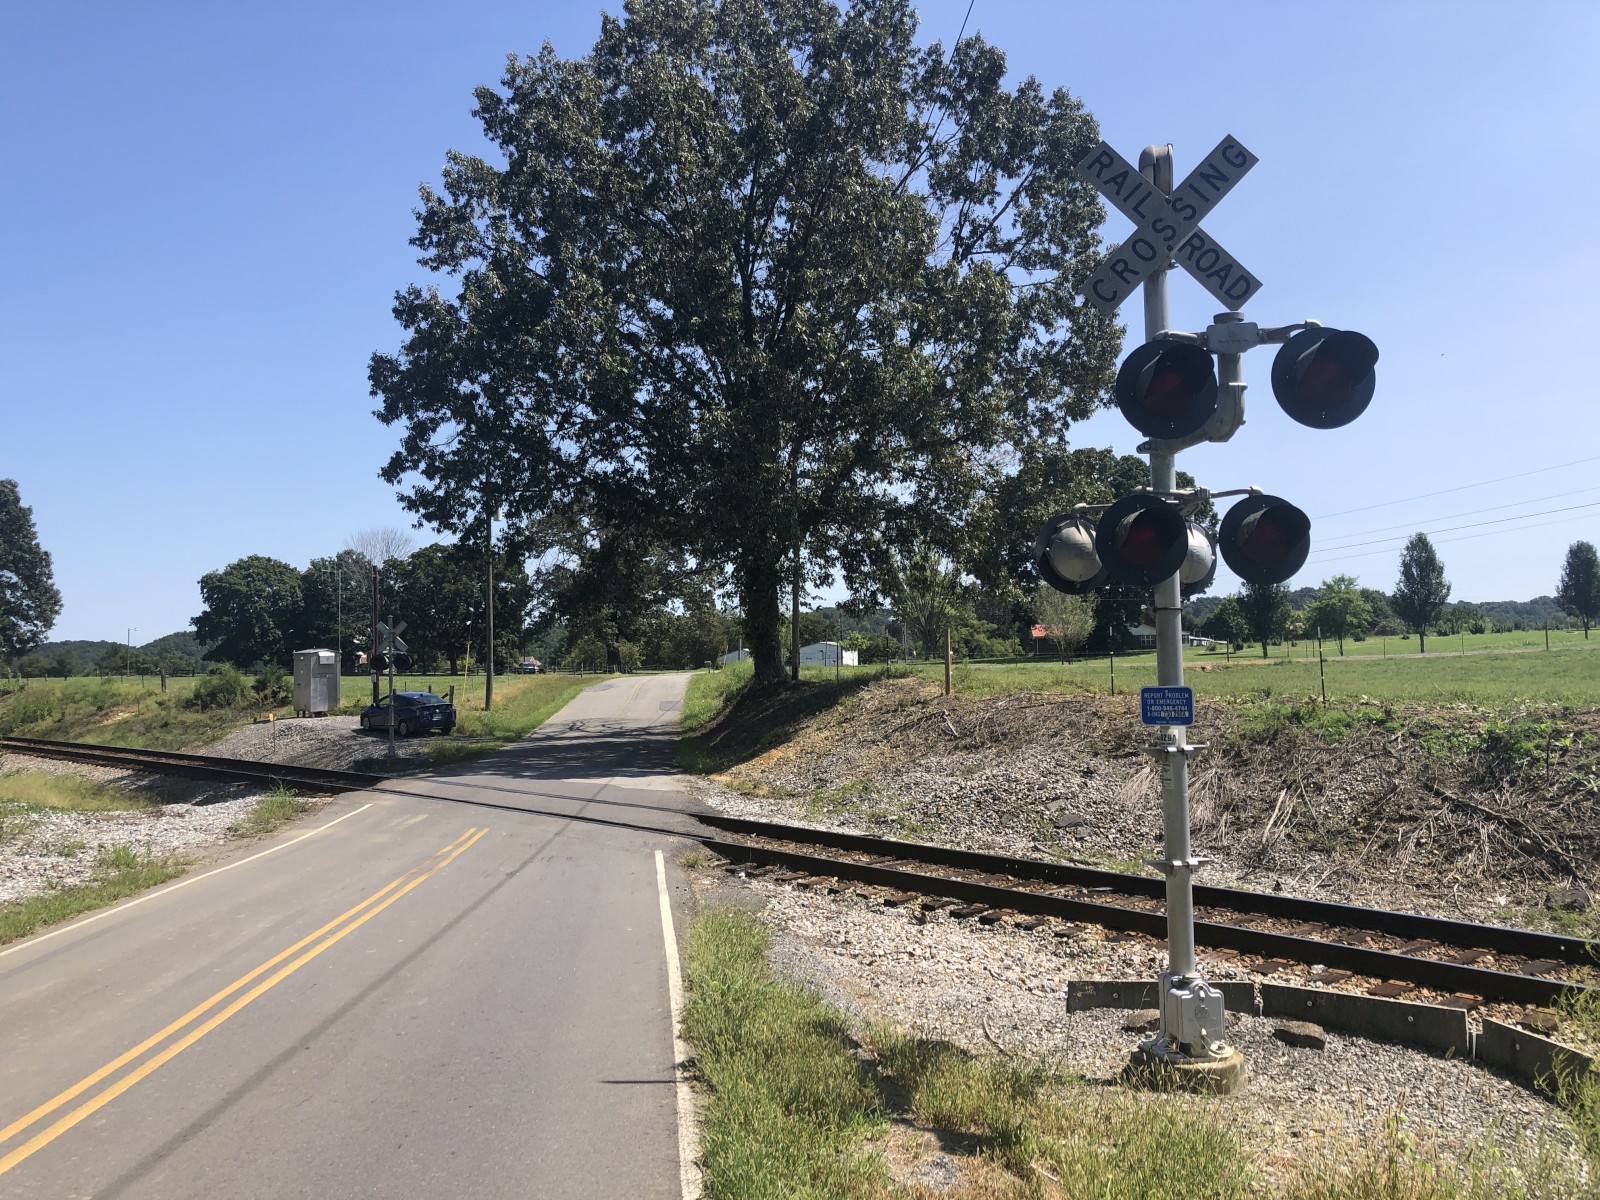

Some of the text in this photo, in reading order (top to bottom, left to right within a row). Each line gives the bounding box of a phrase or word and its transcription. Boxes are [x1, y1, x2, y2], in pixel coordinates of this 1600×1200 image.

[1086, 149, 1251, 301] RAIL ROAD
[1092, 144, 1248, 303] CROSSING
